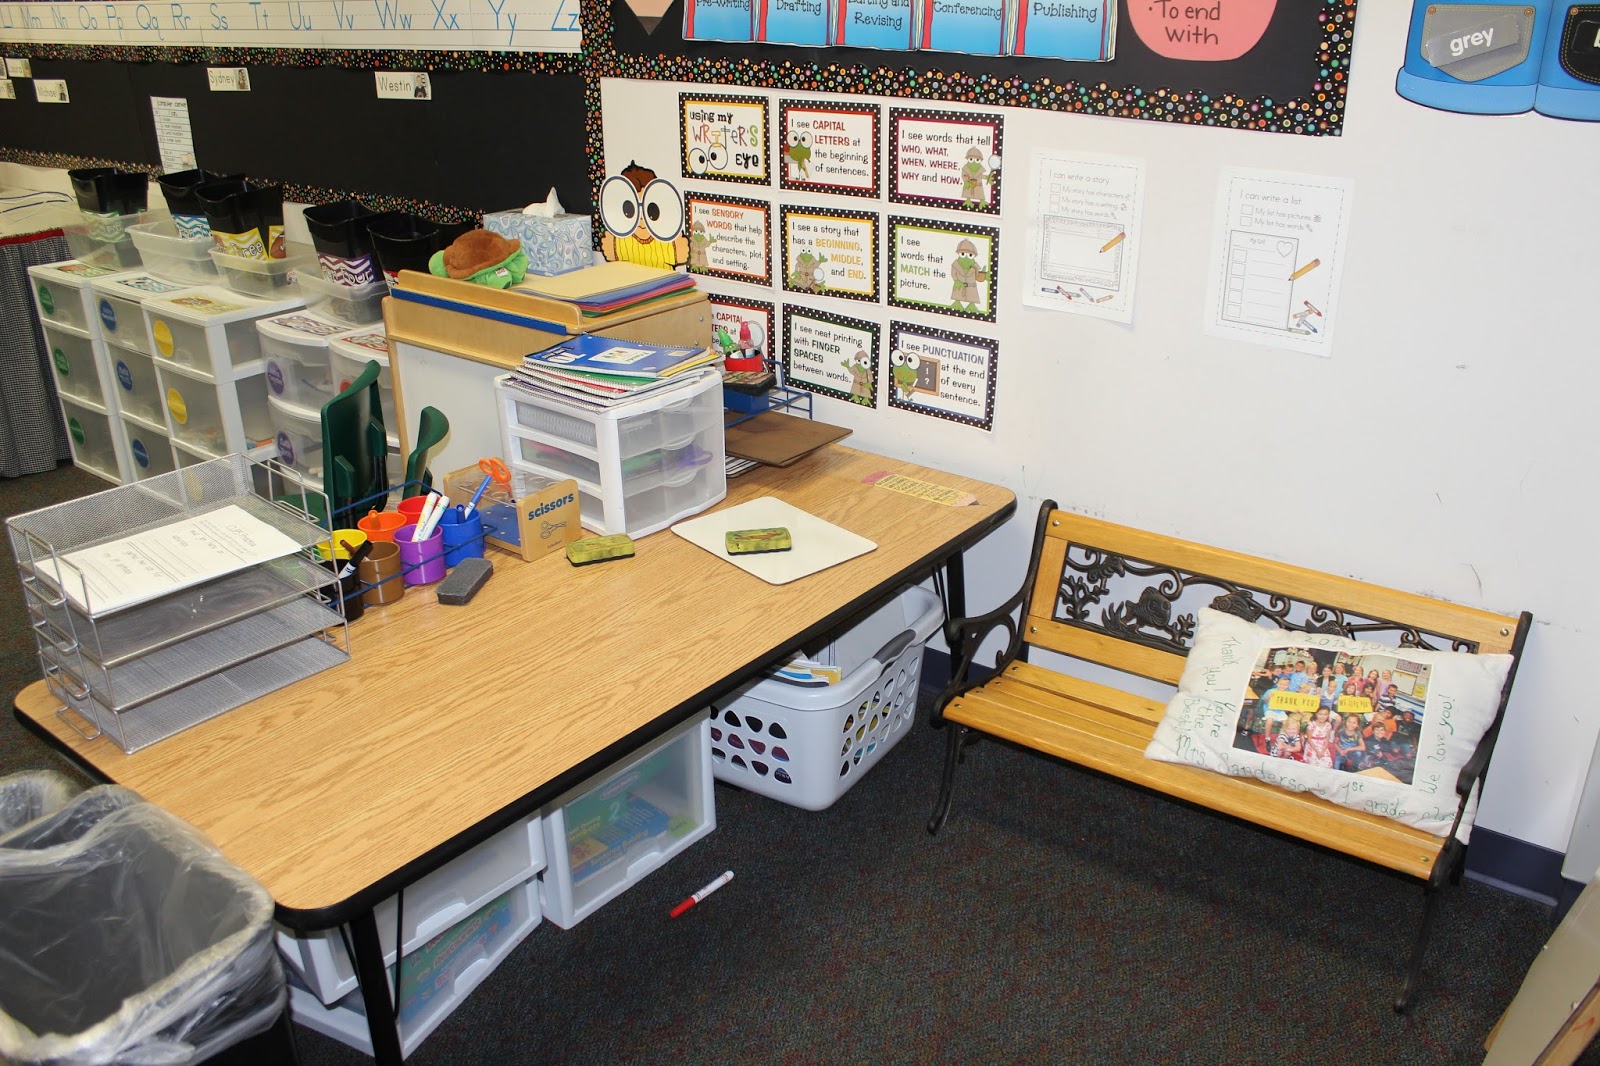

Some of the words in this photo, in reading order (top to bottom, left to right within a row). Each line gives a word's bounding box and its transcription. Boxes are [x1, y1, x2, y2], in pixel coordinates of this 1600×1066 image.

[776, 0, 822, 16] Drafting
[933, 1, 1002, 20] Conferencing
[1033, 2, 1098, 23] Publishing
[1185, 0, 1221, 20] end
[854, 11, 903, 31] Revising
[1450, 28, 1494, 56] grey
[209, 70, 235, 86] Sydney
[378, 76, 412, 92] Westin
[690, 109, 715, 123] using
[717, 112, 734, 124] my
[812, 120, 846, 132] CAPITAL
[814, 134, 850, 146] LETTERS
[852, 138, 861, 146] at
[902, 129, 905, 139] I
[908, 132, 923, 140] see
[926, 132, 952, 143] words
[956, 133, 974, 145] that
[977, 136, 990, 146] tell
[815, 149, 828, 158] the
[830, 150, 869, 164] beginning
[901, 144, 923, 154] WHO,
[924, 146, 949, 157] WHAT,
[815, 163, 824, 172] of
[826, 166, 870, 177] sentences.
[901, 157, 927, 168] WHEN,
[929, 159, 961, 171] WHERE,
[901, 171, 920, 180] WHY
[922, 173, 938, 182] and
[940, 175, 963, 186] HOW.
[1067, 173, 1084, 182] write
[1092, 177, 1110, 185] story
[1245, 192, 1260, 200] can
[1262, 194, 1280, 203] write
[1290, 196, 1302, 206] list
[711, 208, 744, 220] SENSORY
[706, 220, 732, 230] WORDS
[734, 222, 747, 232] that
[748, 225, 763, 236] help
[797, 224, 811, 232] see
[820, 226, 842, 238] story
[844, 226, 860, 236] that
[716, 232, 743, 244] describe
[745, 236, 756, 246] the
[792, 235, 806, 245] has
[815, 238, 863, 252] BEGINNING,
[906, 238, 921, 246] see
[711, 244, 748, 258] characters,
[749, 250, 764, 260] plot,
[830, 253, 864, 266] MIDDLE,
[900, 251, 925, 262] words
[926, 253, 944, 264] that
[712, 256, 724, 265] and
[725, 259, 750, 270] setting.
[900, 264, 931, 276] MATCH
[932, 269, 947, 278] the
[830, 268, 845, 276] and
[848, 269, 867, 280] END.
[900, 279, 931, 290] picture.
[800, 325, 813, 334] see
[814, 328, 831, 338] neat
[833, 333, 863, 348] printing
[794, 336, 810, 346] with
[812, 339, 841, 354] FINGER
[794, 348, 824, 364] SPACES
[906, 342, 920, 352] see
[922, 344, 985, 366] PUNCTUATION
[793, 360, 824, 376] between
[826, 371, 852, 384] words.
[940, 363, 950, 372] at
[952, 365, 967, 376] the
[968, 370, 986, 380] end
[940, 376, 950, 386] of
[952, 381, 976, 394] every
[940, 391, 981, 406] sentence.
[528, 493, 574, 520] scissors
[1221, 636, 1242, 668] Thank
[1194, 704, 1213, 729] the
[1428, 734, 1446, 762] love
[1420, 774, 1440, 794] We
[1364, 799, 1407, 818] grade
